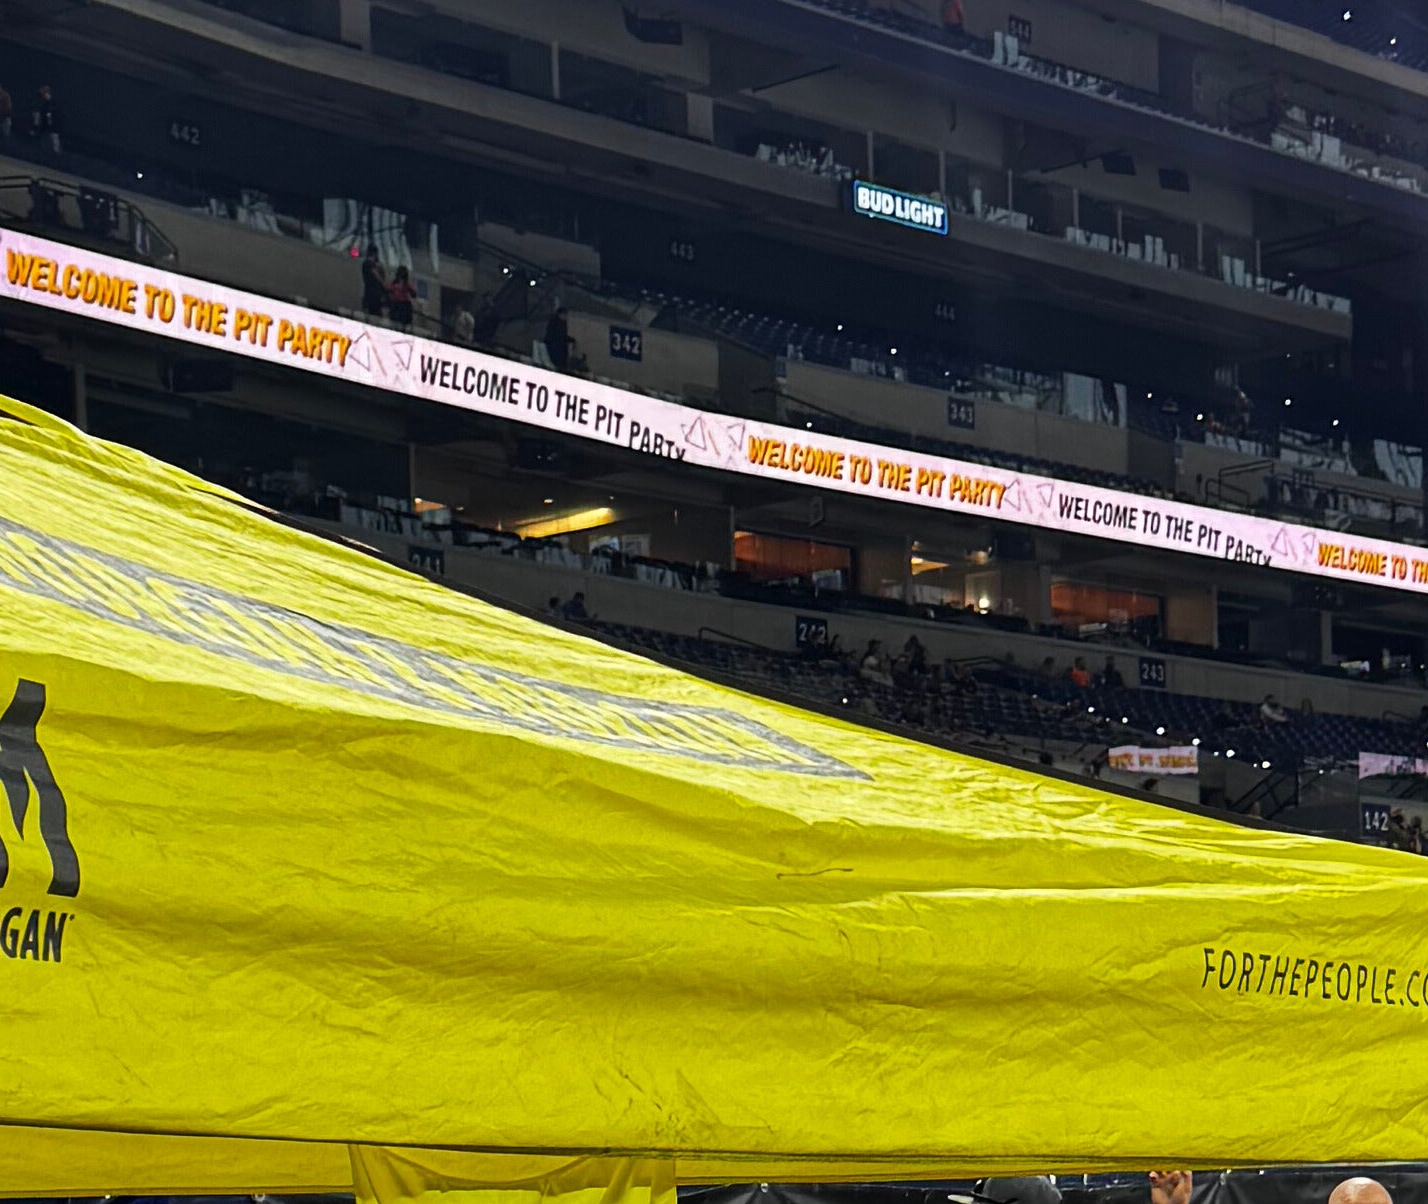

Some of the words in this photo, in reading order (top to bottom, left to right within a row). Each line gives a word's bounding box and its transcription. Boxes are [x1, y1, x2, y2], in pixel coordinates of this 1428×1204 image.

[170, 123, 201, 146] 442
[857, 186, 895, 215] BUD
[894, 196, 944, 228] LIGHT
[6, 248, 138, 314] WELCOME
[144, 283, 176, 324] TO
[181, 295, 228, 337] THE
[233, 308, 274, 348] PIT
[277, 319, 352, 367] PARTY
[612, 332, 640, 355] 342
[420, 354, 520, 405] WELCOME
[526, 381, 549, 413] TO
[555, 390, 590, 425] THE
[595, 405, 624, 440] PIT
[748, 434, 845, 481] WELCOME
[849, 454, 872, 485] TO
[877, 460, 912, 492] THE
[916, 468, 946, 499] PIT
[949, 474, 1007, 510] PARTY
[1059, 493, 1139, 530] WELCOME
[1142, 509, 1162, 535] TO
[1165, 515, 1194, 542] THE
[1197, 524, 1222, 552] PIT
[1317, 542, 1388, 577] WELCOME
[1391, 555, 1408, 580] TO
[1141, 663, 1164, 681] 243
[1365, 811, 1389, 831] 142
